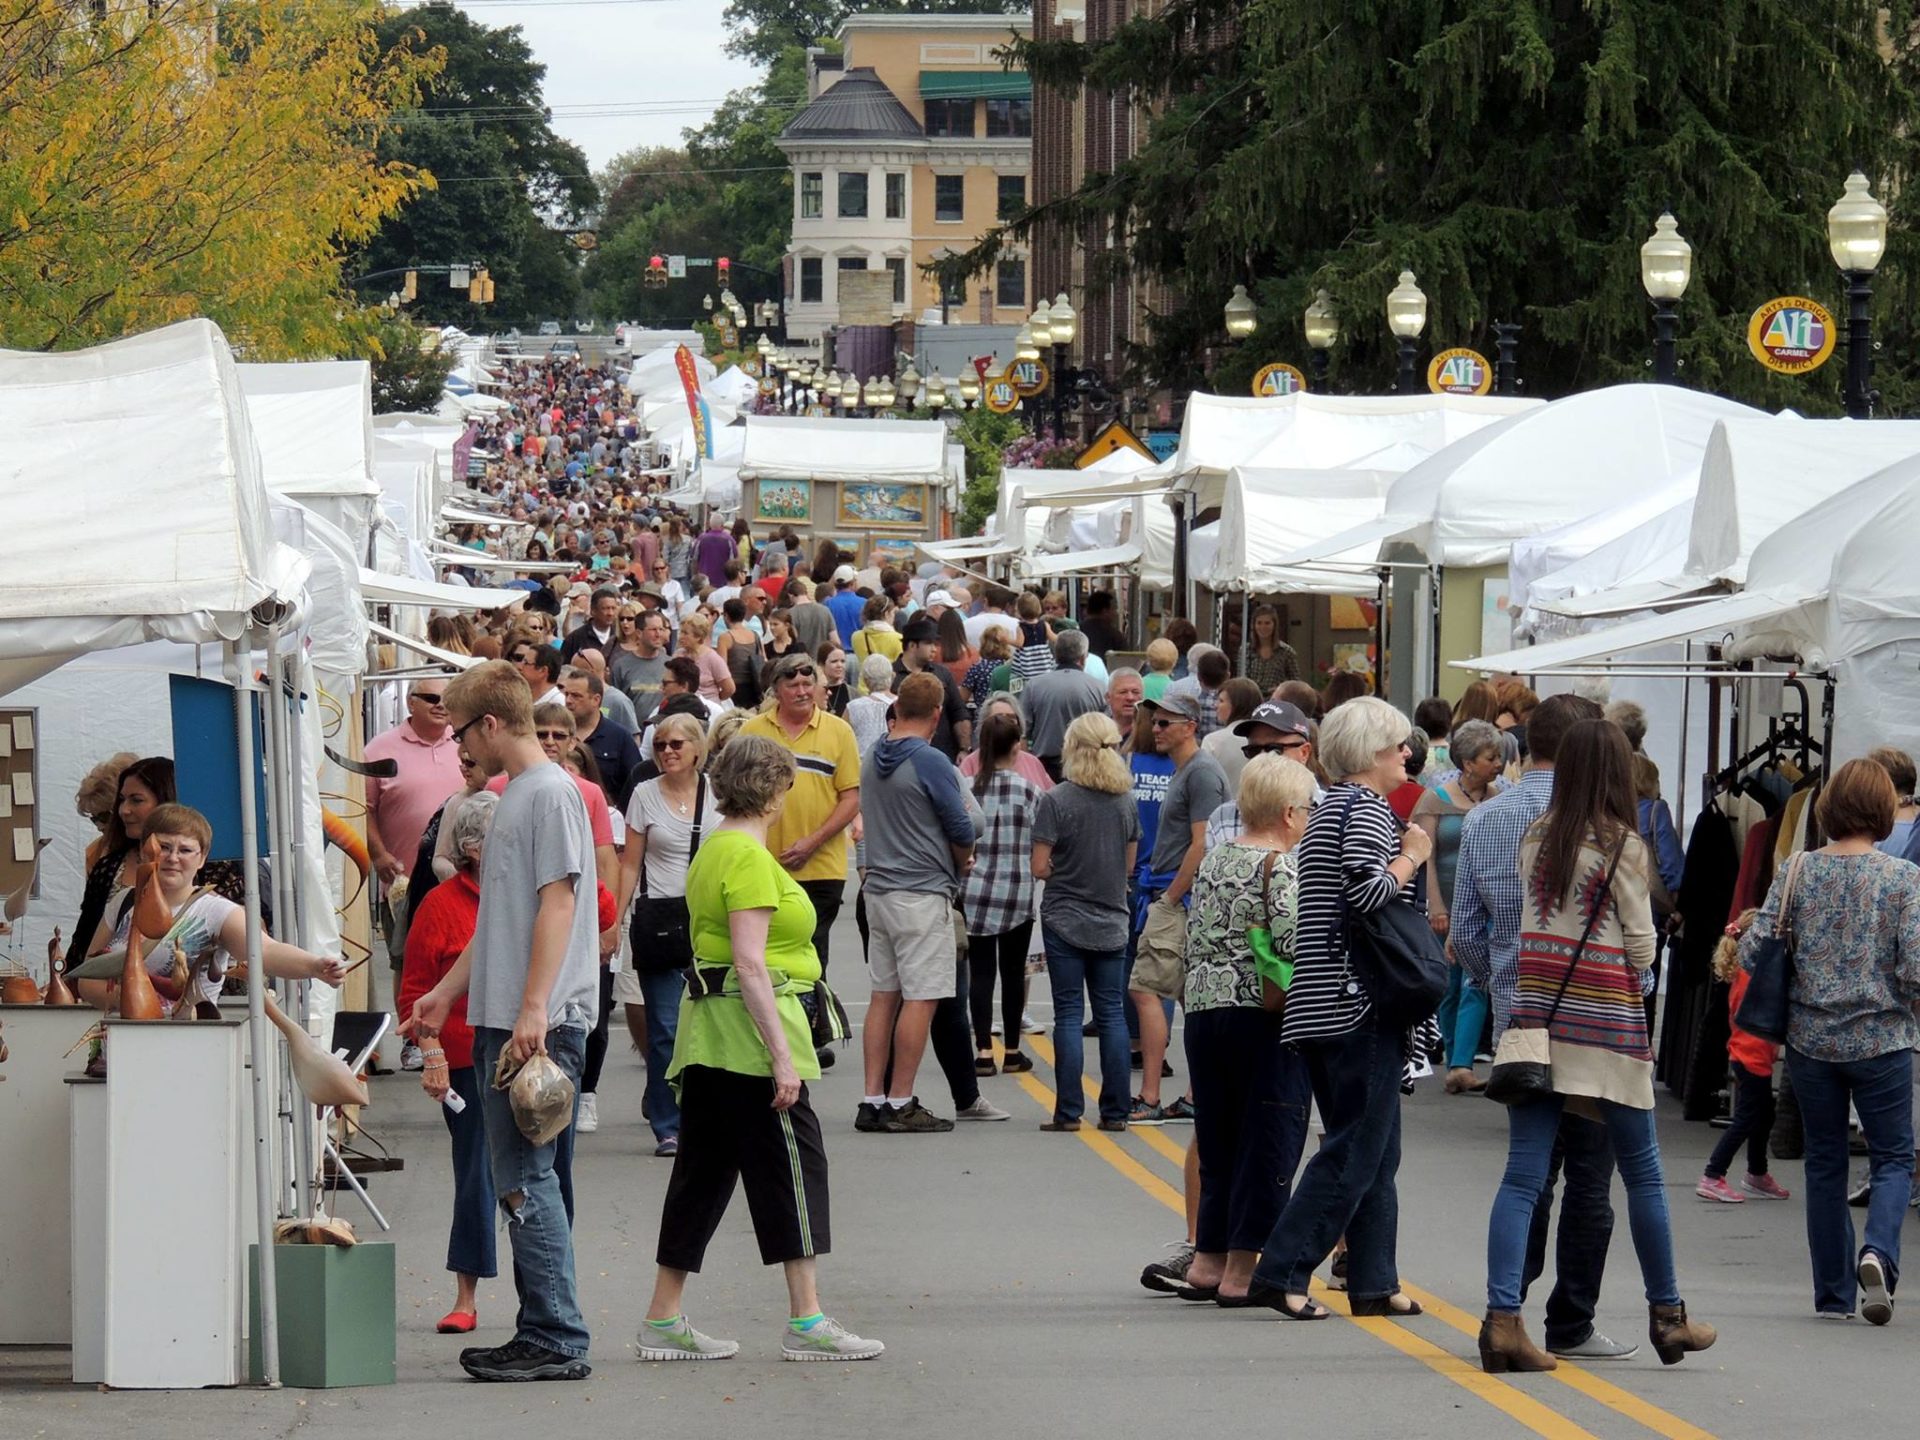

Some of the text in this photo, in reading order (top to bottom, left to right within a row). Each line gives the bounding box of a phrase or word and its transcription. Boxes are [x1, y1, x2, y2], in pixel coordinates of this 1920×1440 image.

[1760, 301, 1784, 320] ARTS
[1794, 299, 1829, 322] DESIGN
[1763, 309, 1823, 350] Art
[1774, 348, 1810, 357] CARMEL
[1438, 358, 1482, 386] Art
[1767, 356, 1815, 370] DISTRICT
[1135, 789, 1151, 801] PER
